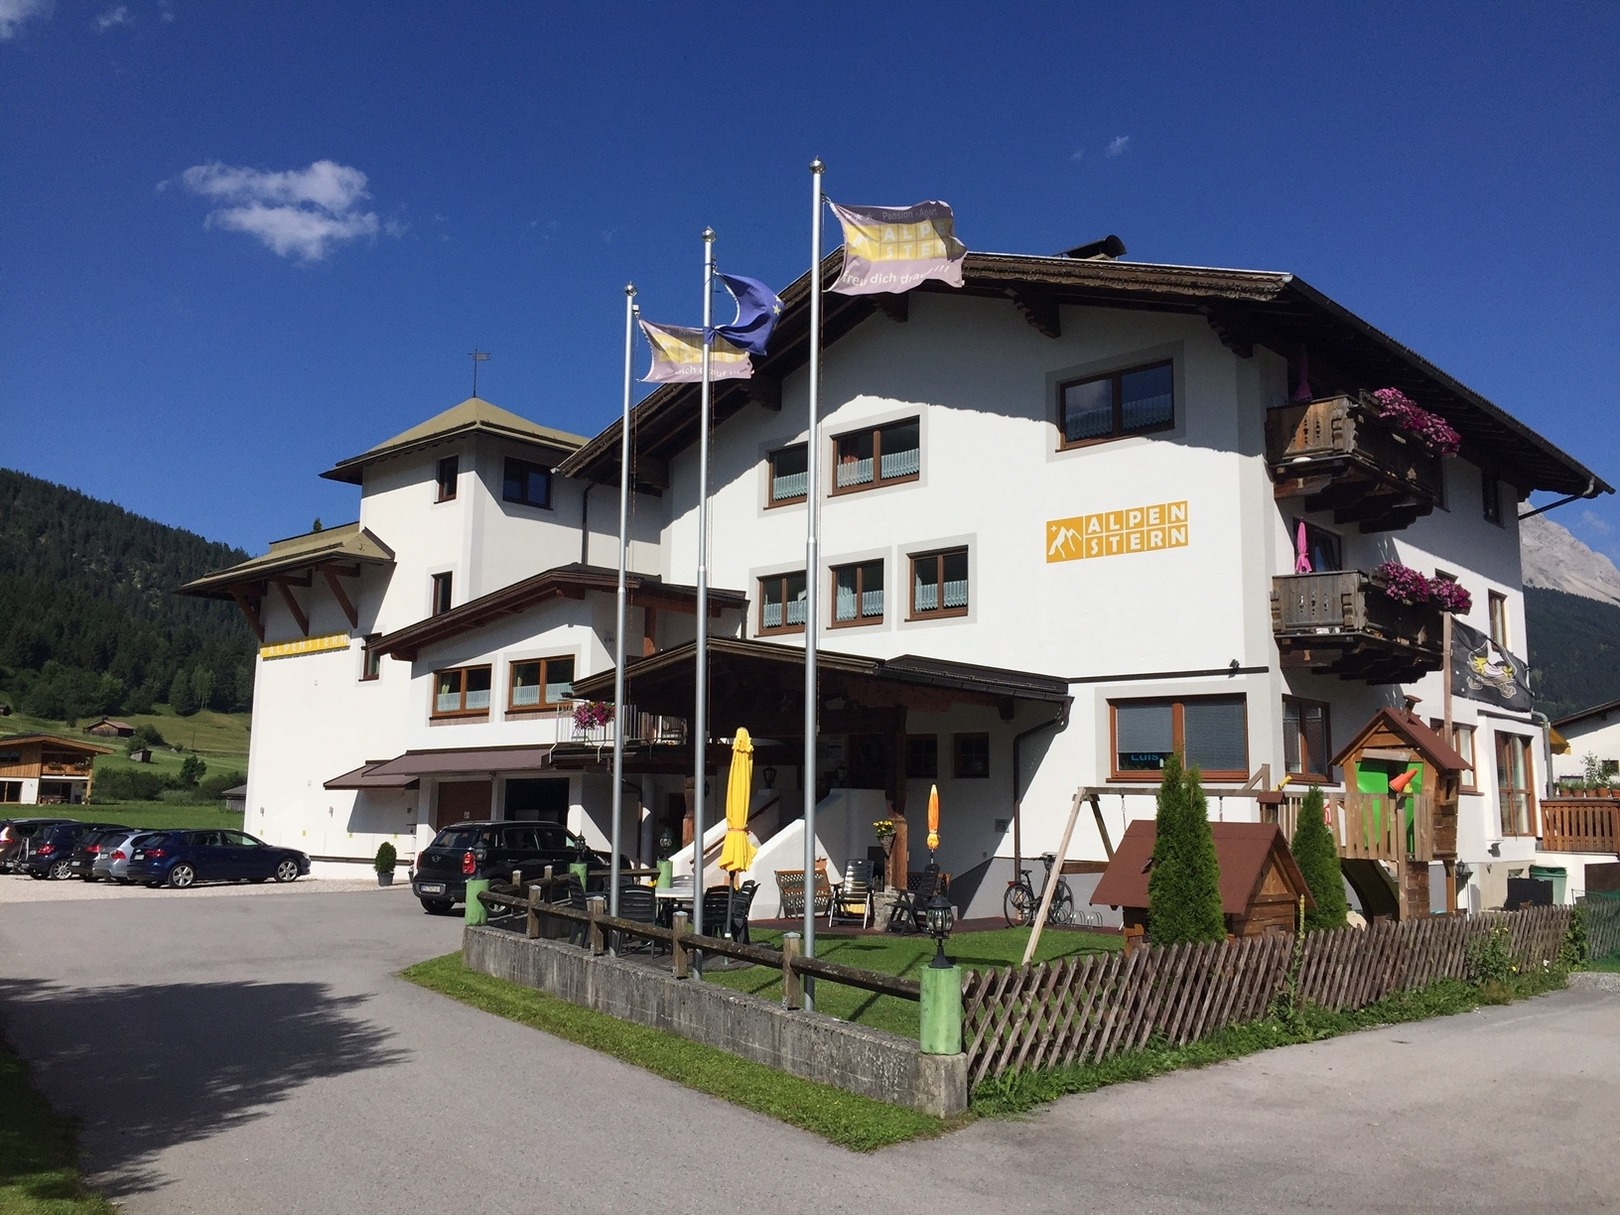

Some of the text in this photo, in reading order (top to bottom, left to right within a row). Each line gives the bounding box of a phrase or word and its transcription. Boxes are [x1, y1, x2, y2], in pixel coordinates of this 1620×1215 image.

[882, 210, 914, 221] Pension
[884, 221, 946, 241] ALPE
[870, 272, 897, 284] dich
[1087, 504, 1186, 534] ALPEN
[1090, 527, 1186, 556] STERN
